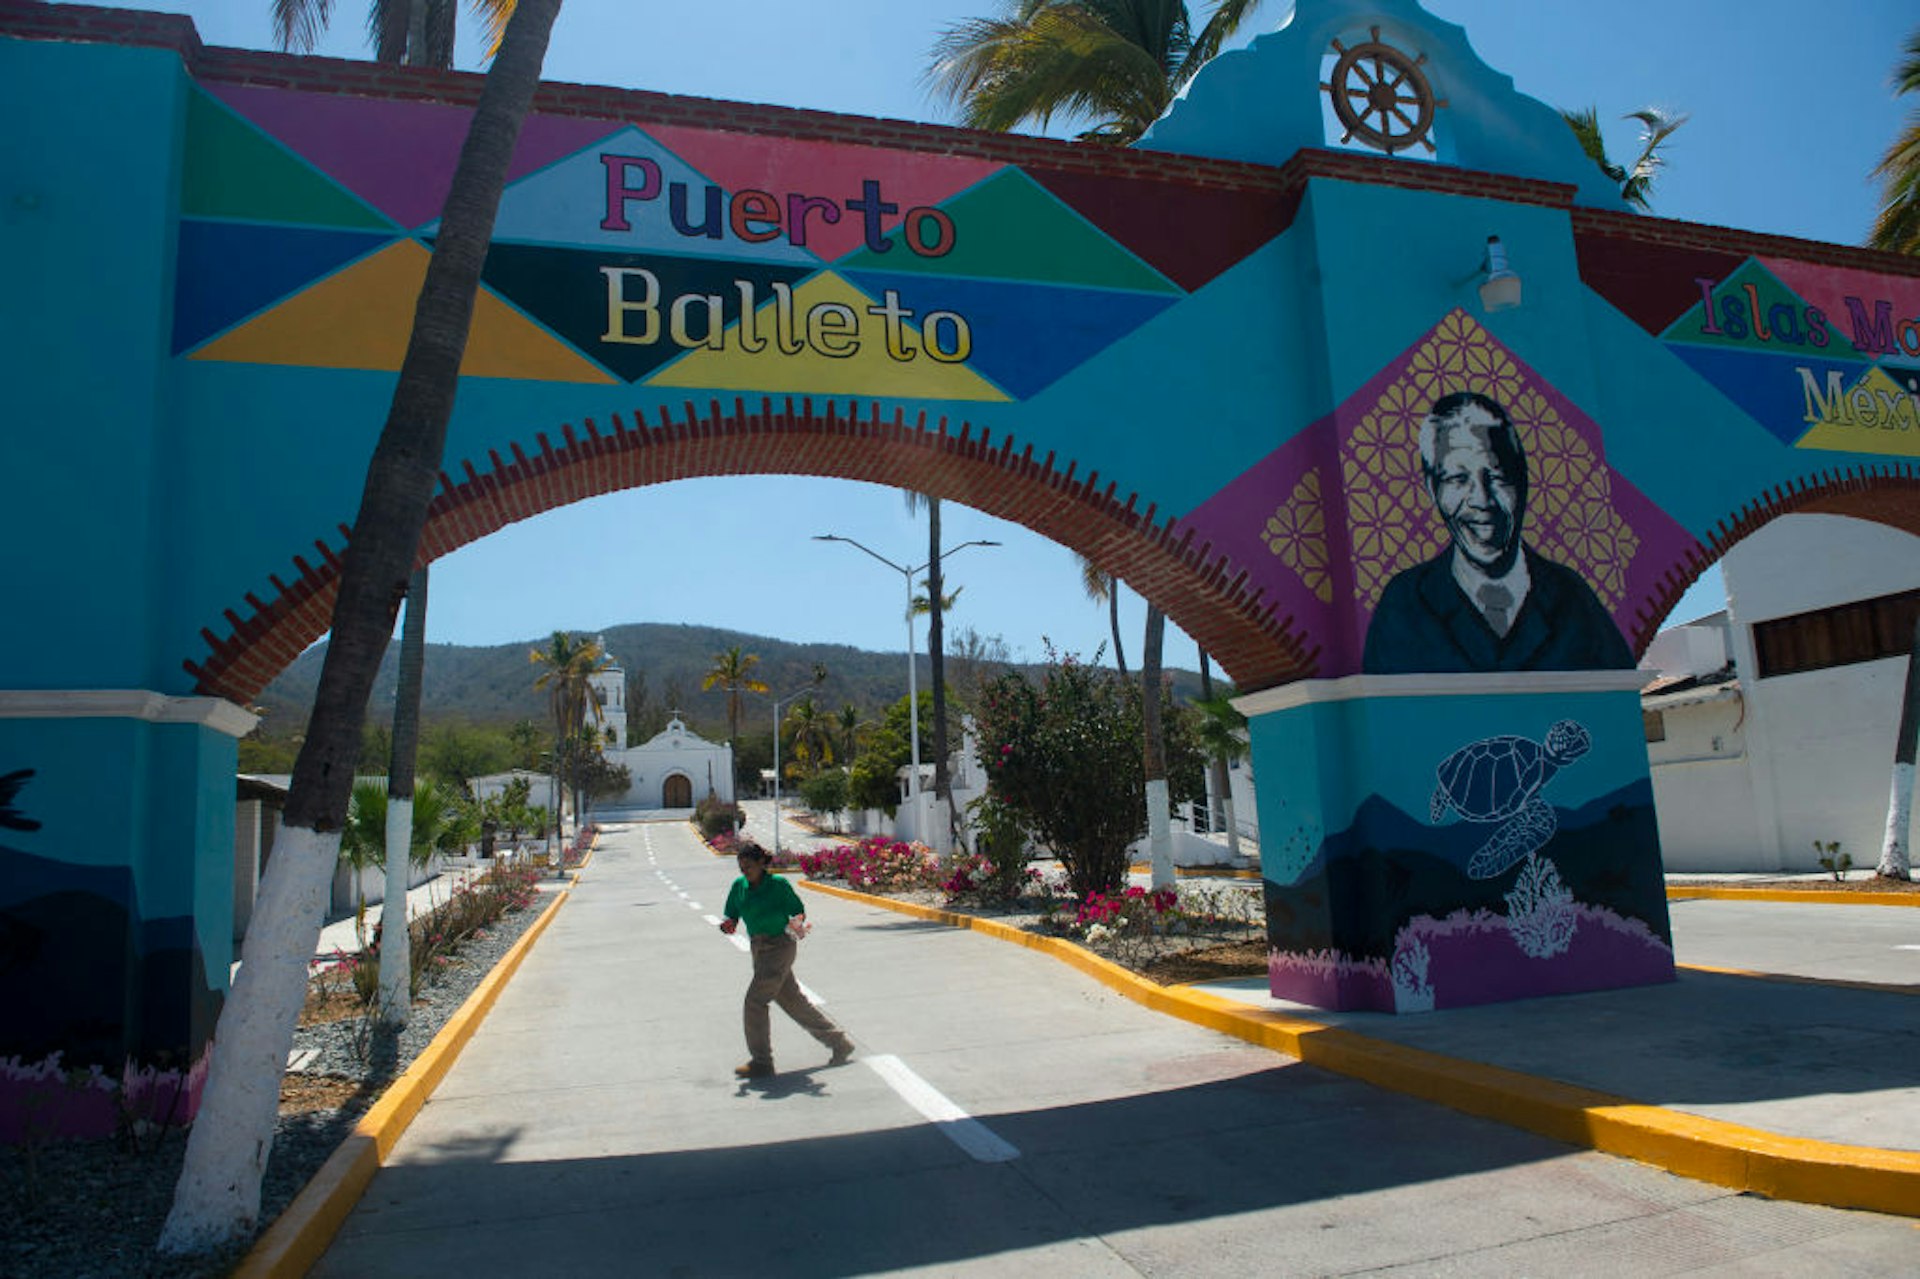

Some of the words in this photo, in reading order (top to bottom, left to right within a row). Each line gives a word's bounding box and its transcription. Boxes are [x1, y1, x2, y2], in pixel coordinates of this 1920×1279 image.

[600, 154, 956, 258] Puerto
[600, 266, 972, 363] Balleto
[1694, 278, 1829, 348] Islas
